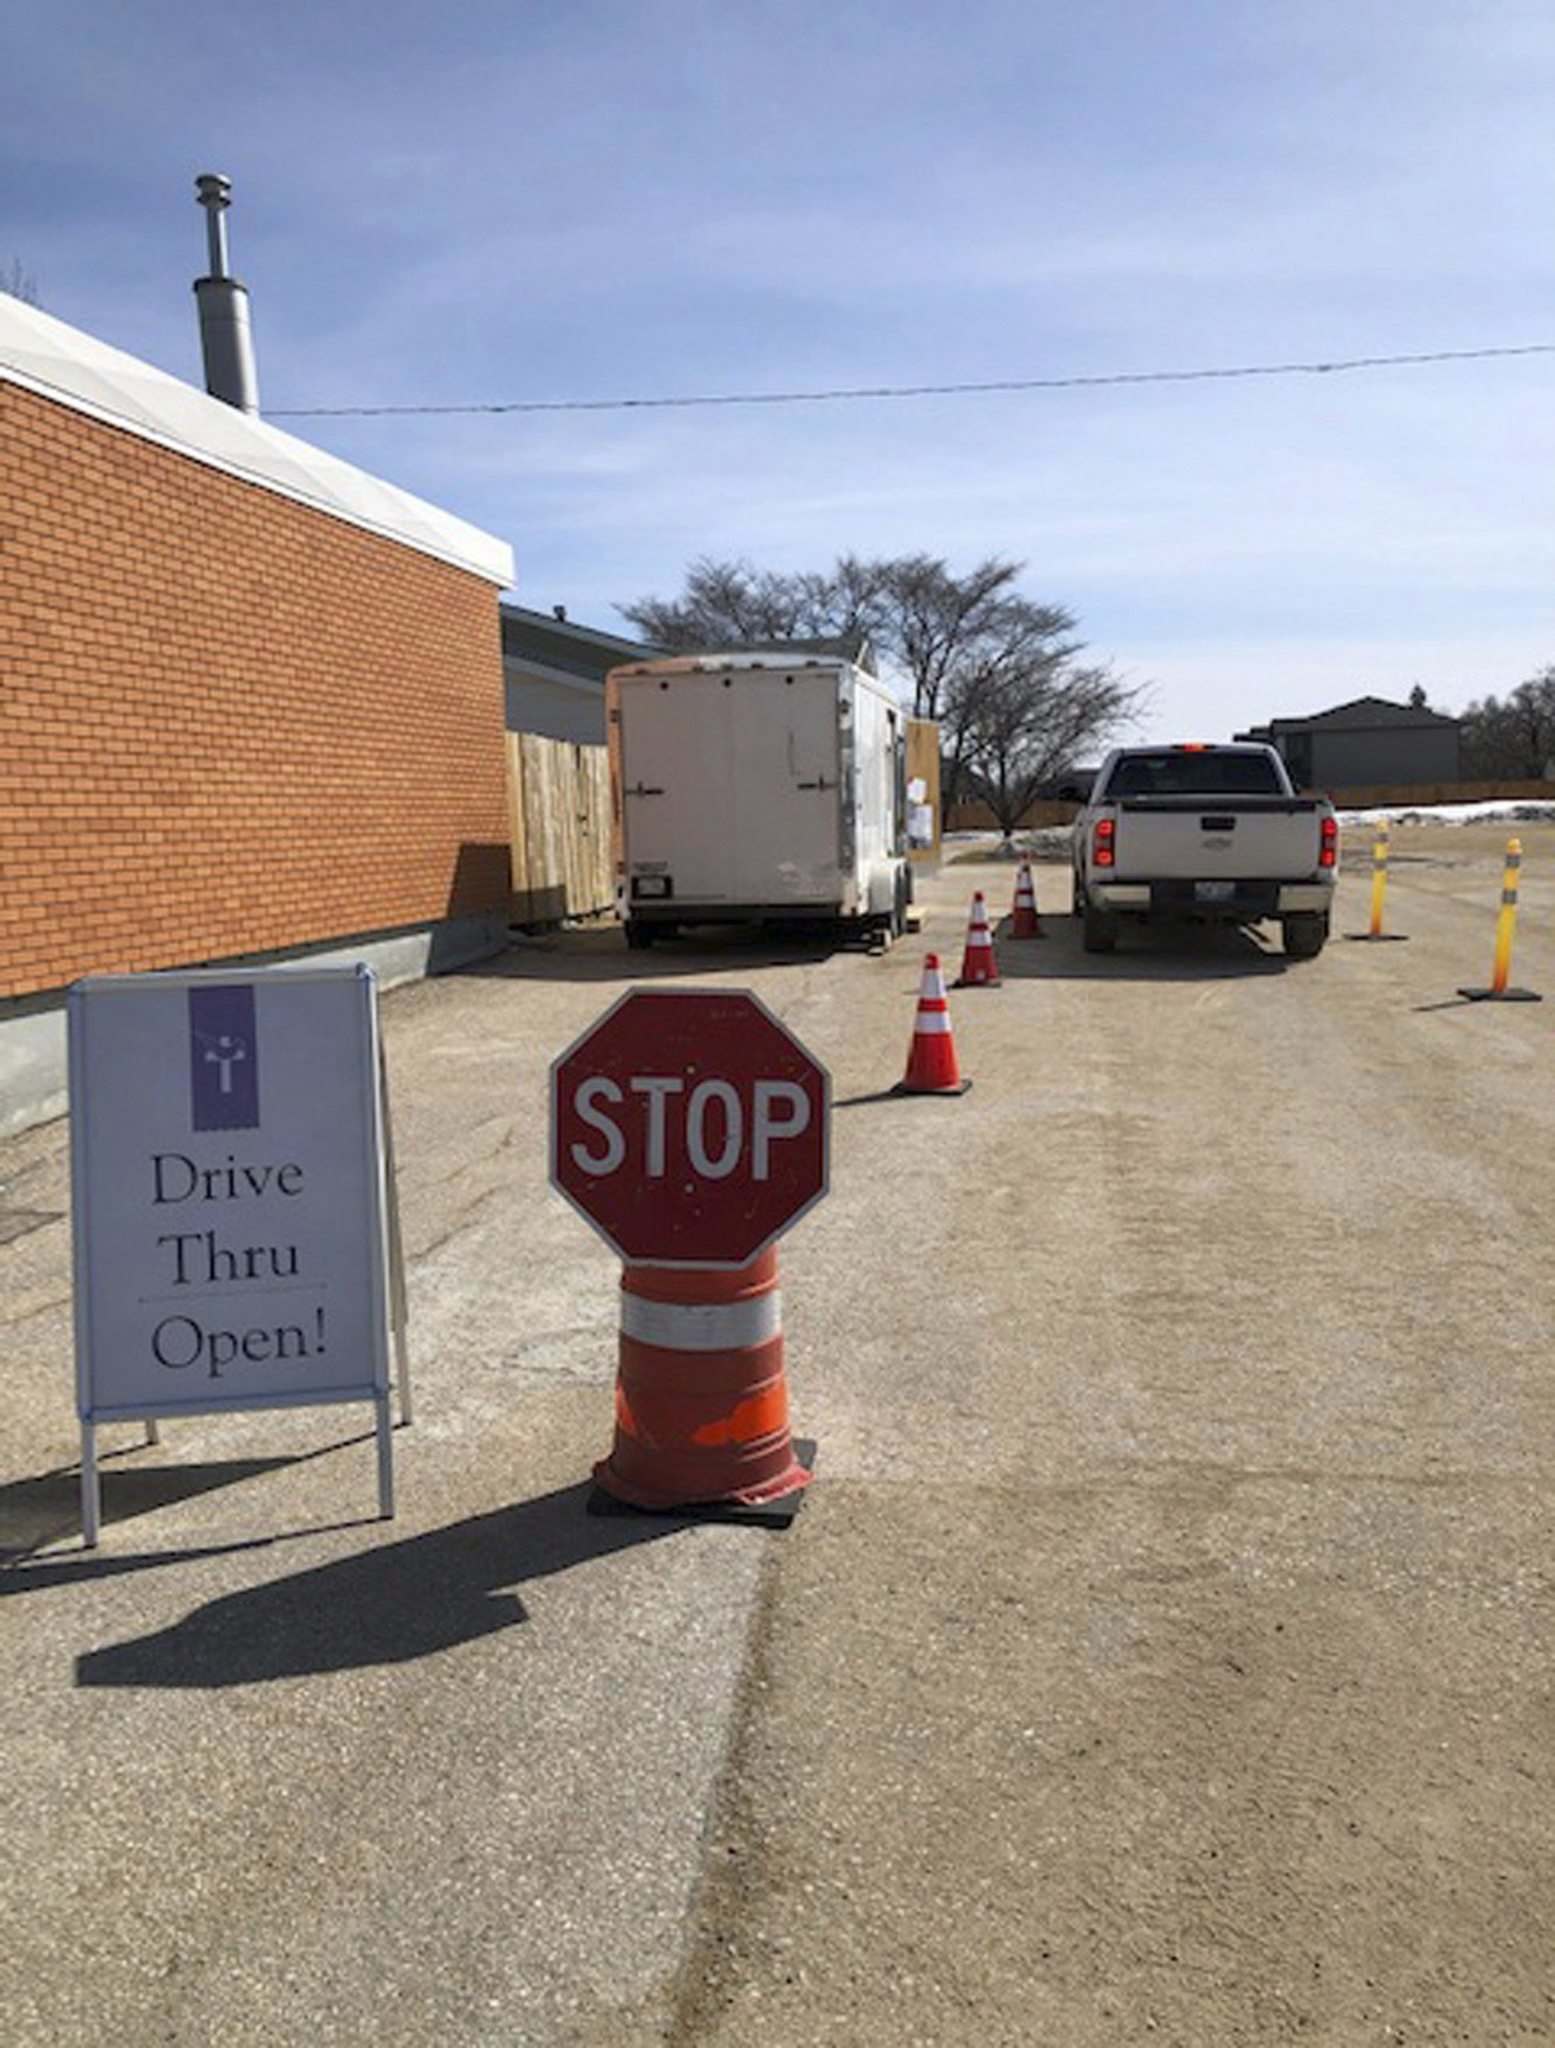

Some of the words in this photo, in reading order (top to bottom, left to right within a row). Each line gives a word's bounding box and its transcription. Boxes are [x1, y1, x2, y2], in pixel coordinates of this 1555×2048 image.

[570, 1076, 811, 1181] STOP
[151, 1152, 304, 1205] Drive
[157, 1230, 300, 1286] Thru
[151, 1307, 327, 1378] Open!
